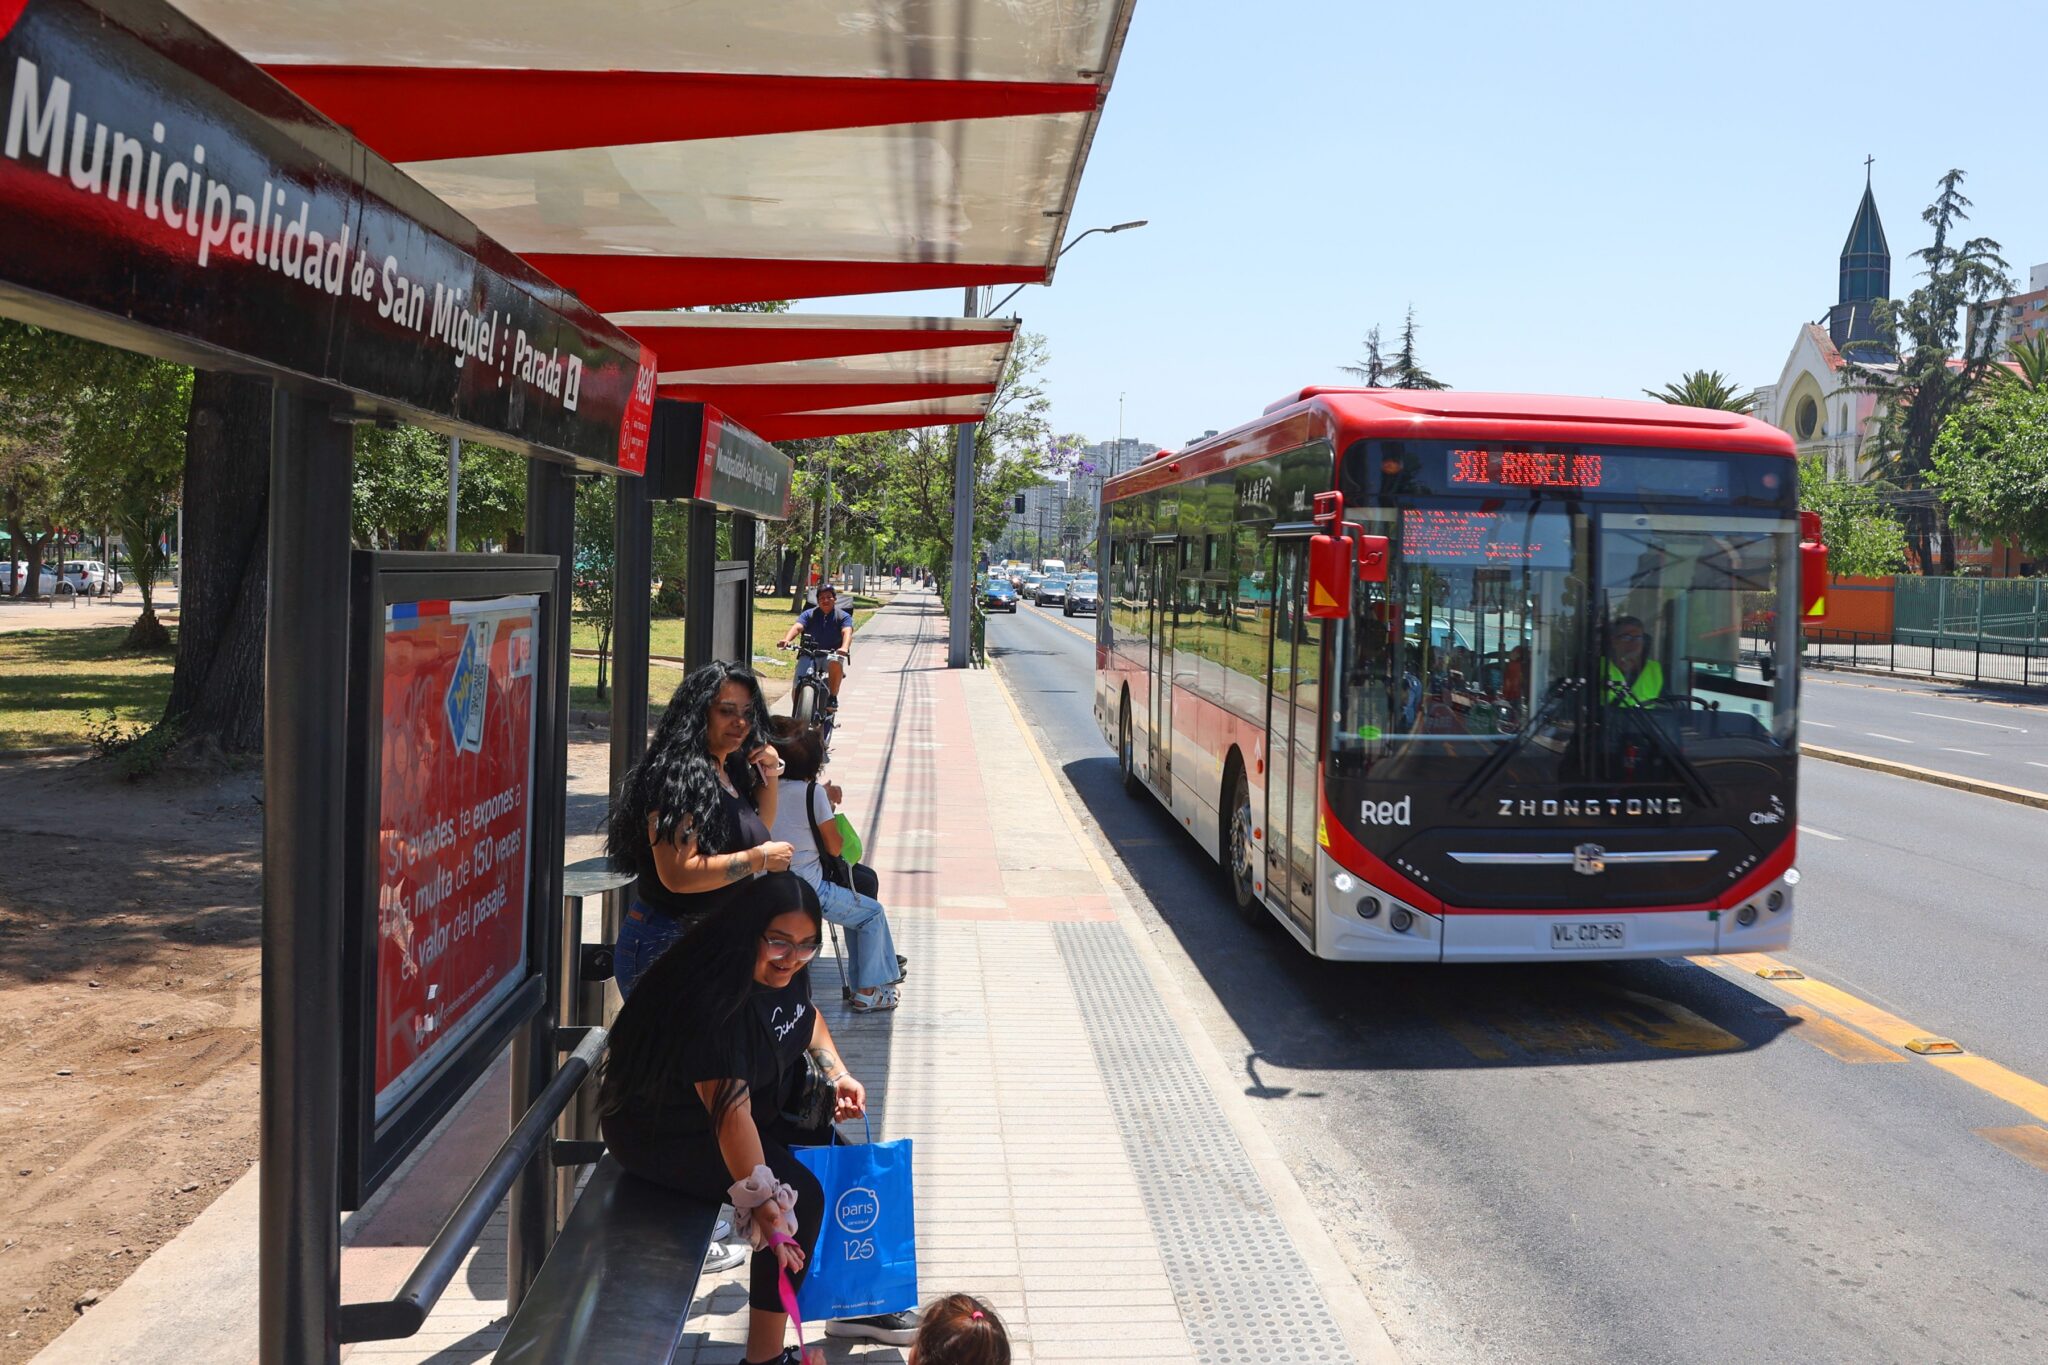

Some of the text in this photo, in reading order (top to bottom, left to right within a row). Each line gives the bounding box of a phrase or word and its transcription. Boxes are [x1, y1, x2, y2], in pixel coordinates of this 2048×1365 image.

[5, 56, 350, 296] Municipalidad
[351, 250, 375, 302] de
[378, 255, 425, 332] San
[430, 282, 498, 368] Miguel
[512, 329, 562, 398] Parada
[407, 811, 457, 866] evades,
[459, 807, 471, 838] te
[473, 786, 514, 833] expones
[515, 784, 522, 806] a
[1360, 795, 1411, 825] Red
[1499, 798, 1683, 817] ZHONGTONG
[415, 864, 452, 918] multa
[456, 851, 471, 891] de
[473, 836, 493, 878] 150
[495, 827, 521, 862] veces
[418, 919, 452, 968] valor
[453, 896, 471, 942] del
[473, 882, 507, 937] pasaje.
[842, 1203, 874, 1219] paris
[843, 1238, 875, 1261] 125
